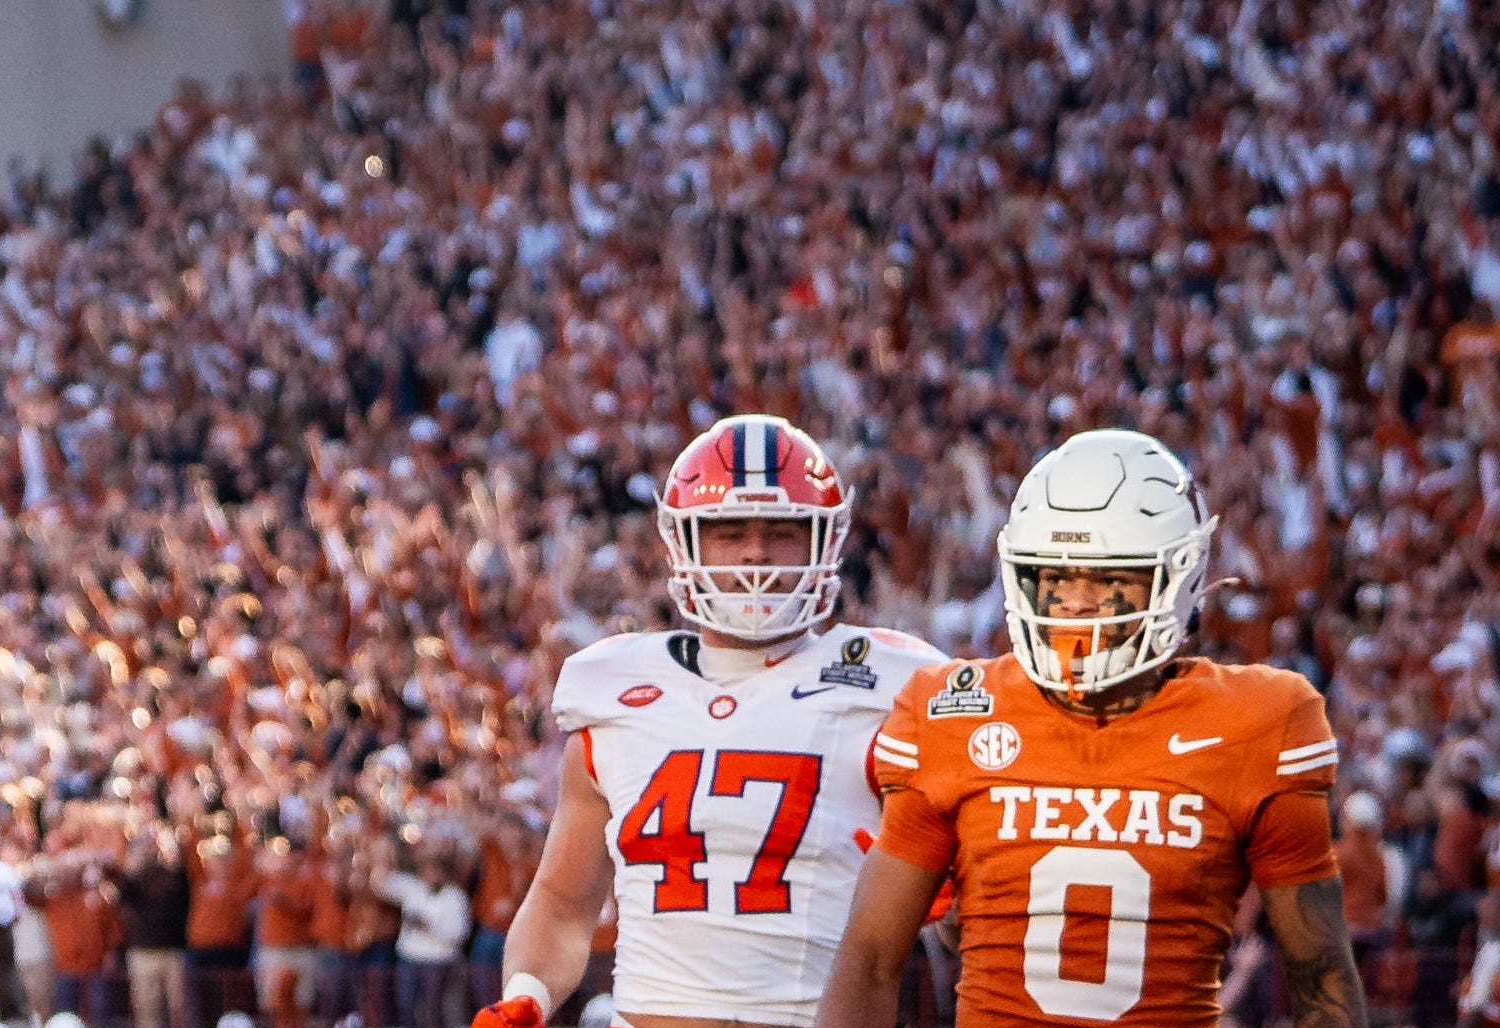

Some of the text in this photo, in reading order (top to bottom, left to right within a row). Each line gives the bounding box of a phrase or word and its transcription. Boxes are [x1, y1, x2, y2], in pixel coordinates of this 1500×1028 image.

[972, 725, 1018, 768] SEC
[617, 748, 823, 915] 47
[990, 786, 1204, 849] TEXAS
[1023, 845, 1151, 1021] 0
